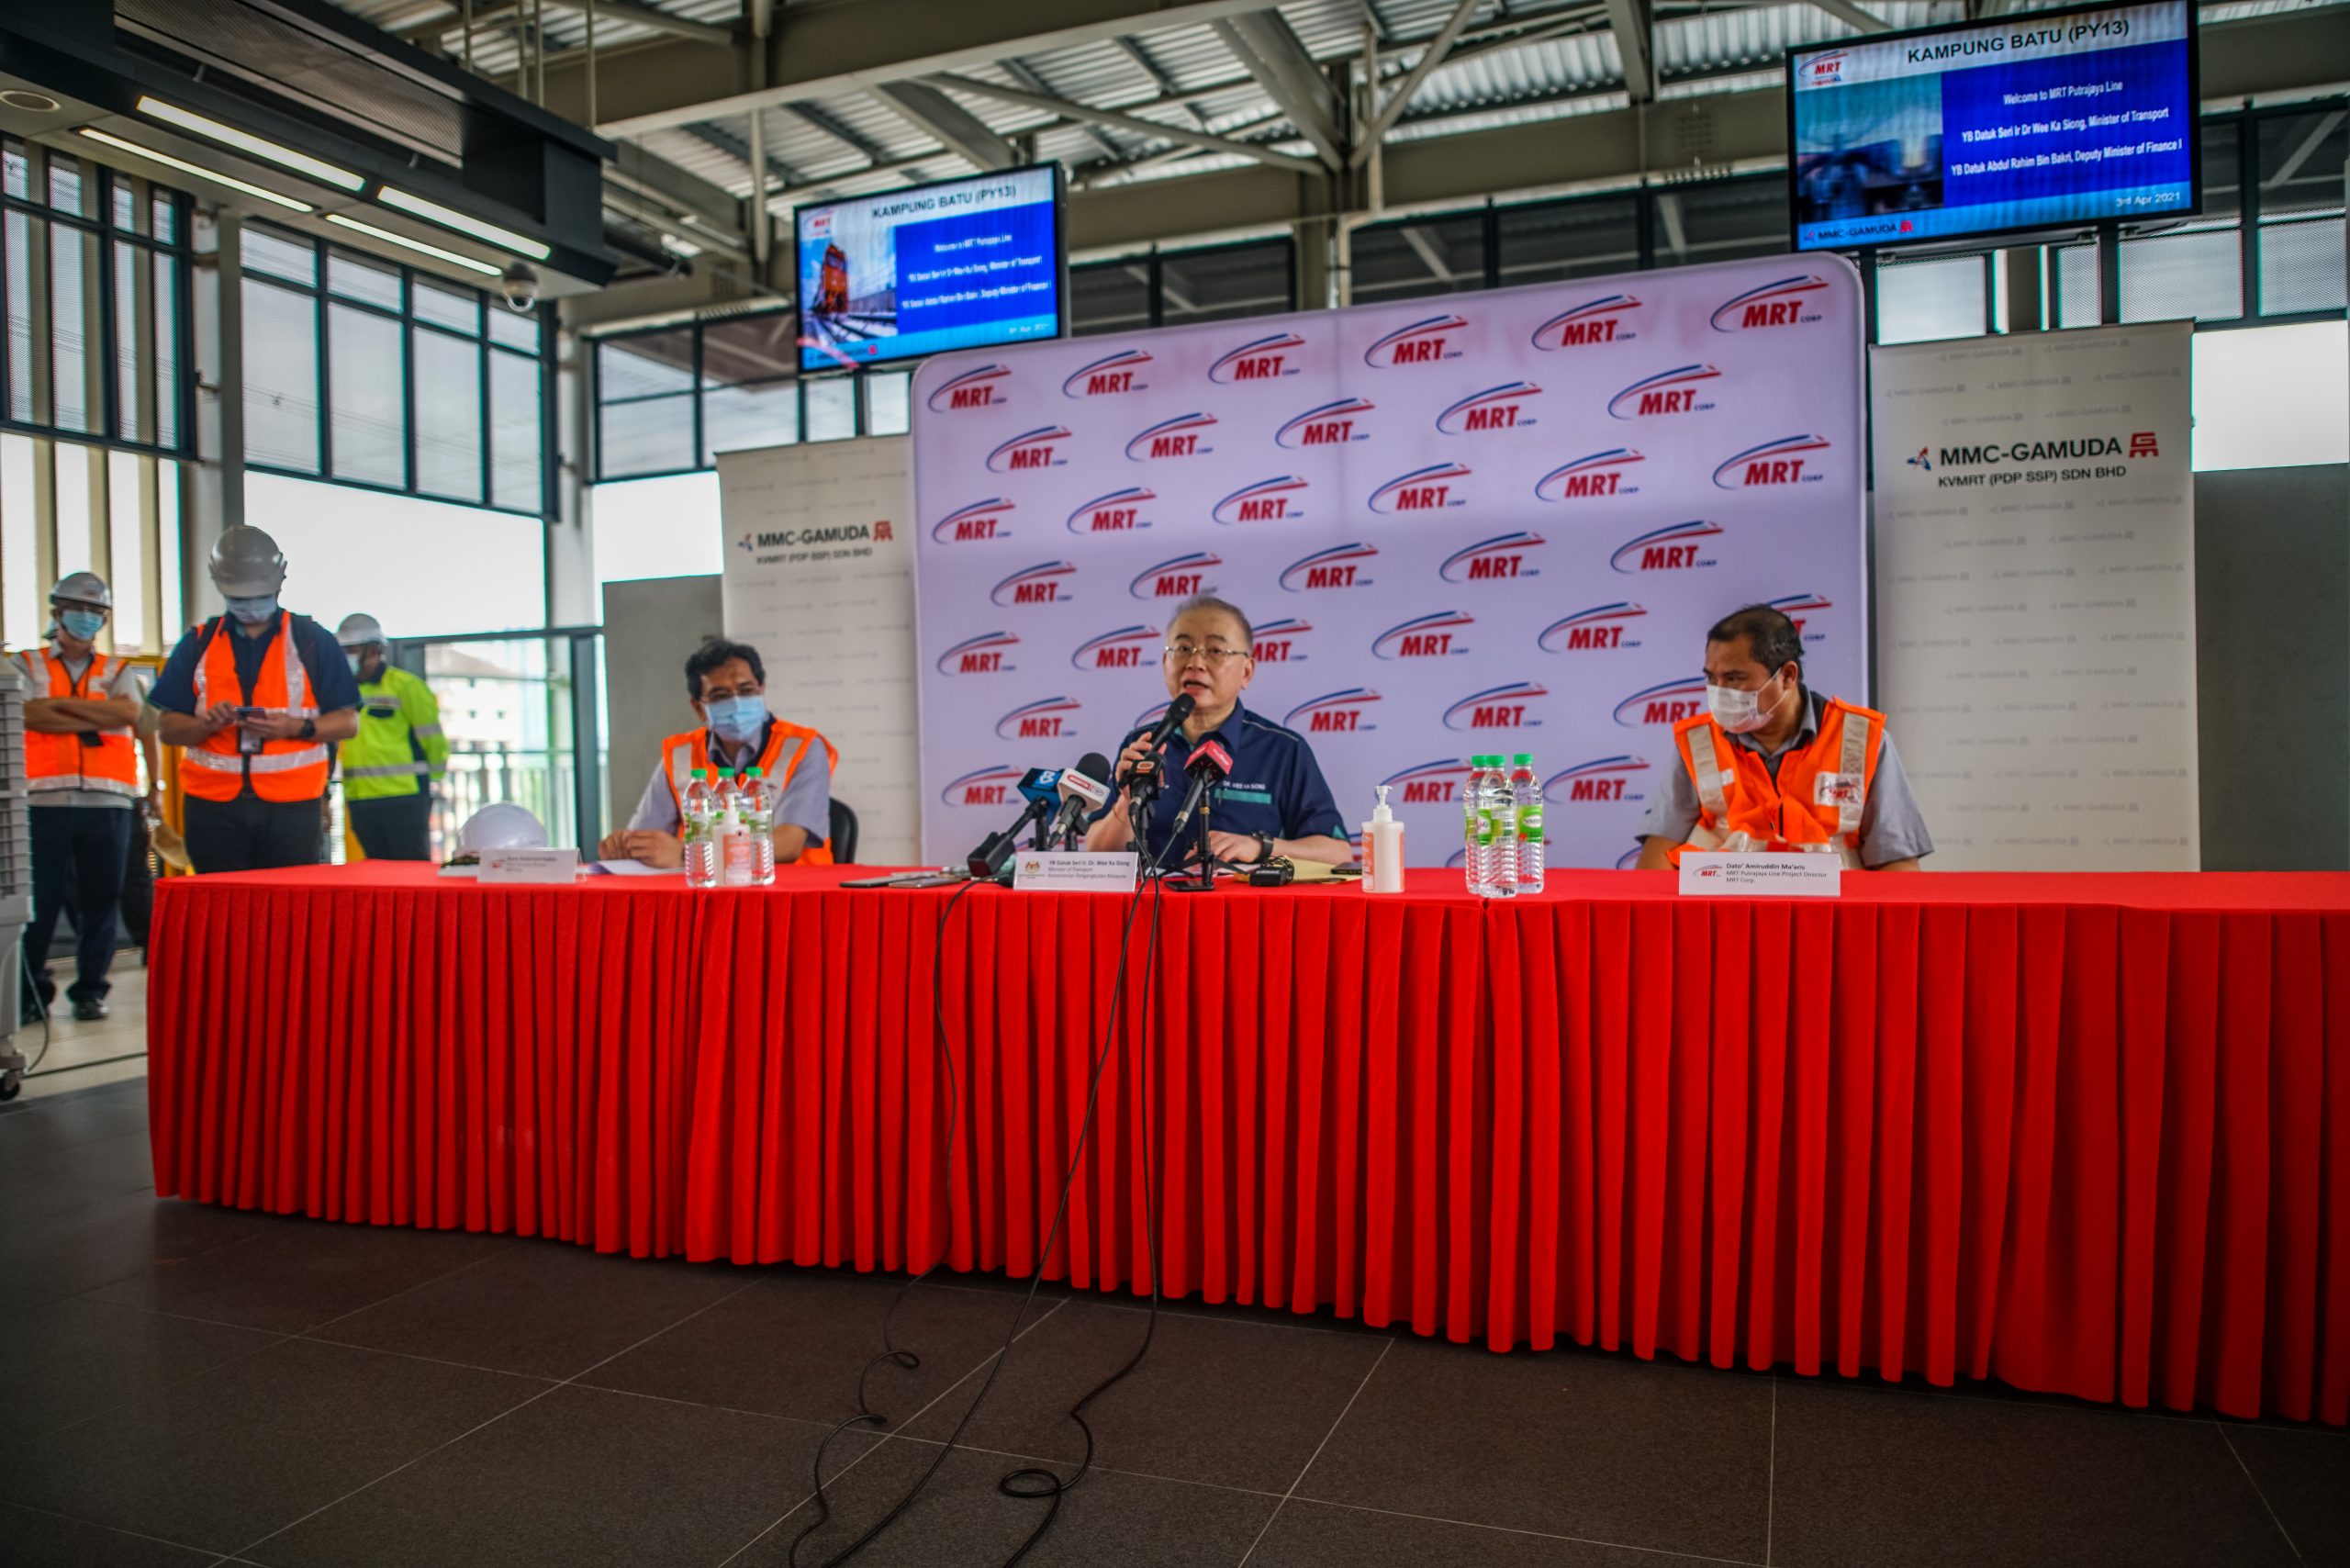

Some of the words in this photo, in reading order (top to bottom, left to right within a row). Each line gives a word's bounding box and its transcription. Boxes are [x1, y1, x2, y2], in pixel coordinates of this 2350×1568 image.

[1908, 37, 2004, 63] KAMPUNG
[2011, 28, 2062, 49] BATU
[2068, 19, 2130, 43] (PY13)
[1815, 61, 1841, 74] MRT
[2003, 93, 2038, 105] Welcome
[2040, 91, 2048, 100] to
[2049, 87, 2066, 99] MRT
[2068, 84, 2104, 97] Putrajaya
[2106, 81, 2123, 92] Line
[1962, 130, 1974, 142] YB
[2088, 114, 2120, 127] Minister
[2121, 111, 2130, 123] of
[2131, 106, 2169, 122] Transport
[1951, 163, 1963, 176] YB
[2103, 145, 2135, 159] Minister
[2136, 141, 2144, 154] of
[2145, 140, 2177, 153] Finance
[873, 199, 934, 218] KAMPUNG
[939, 191, 973, 207] BATU
[2134, 195, 2152, 206] Apr
[2154, 191, 2180, 203] 2021
[1741, 301, 1800, 329] MRT
[1799, 314, 1823, 323] CORP
[1561, 319, 1617, 347] MRT
[1615, 331, 1637, 342] CORP
[1392, 338, 1445, 364] MRT
[1444, 351, 1464, 360] CORP
[1235, 355, 1283, 380] MRT
[1087, 372, 1133, 395] MRT
[950, 386, 993, 409] MRT
[1638, 389, 1695, 415] MRT
[1693, 402, 1717, 412] CORP
[1465, 405, 1518, 431] MRT
[1516, 418, 1538, 427] CORP
[1303, 421, 1353, 444] MRT
[1009, 446, 1052, 469] MRT
[1149, 434, 1197, 458] MRT
[1940, 436, 2122, 466] MMC-GAMUDA
[1744, 460, 1804, 486] MRT
[1801, 474, 1825, 483] CORP
[1938, 474, 1986, 487] KVMRT
[1990, 472, 2022, 487] (PDP
[2026, 470, 2057, 484] SSP)
[2061, 467, 2091, 480] SDN
[2095, 465, 2126, 478] BHD
[1564, 473, 1620, 498] MRT
[1617, 486, 1640, 495] CORP
[1237, 498, 1286, 521] MRT
[1396, 487, 1449, 510] MRT
[1446, 498, 1467, 508] CORP
[955, 520, 997, 540] MRT
[1091, 509, 1136, 531] MRT
[757, 524, 870, 548] MMC-GAMUDA
[1468, 556, 1522, 579] MRT
[1519, 568, 1541, 577] CORP
[1640, 545, 1697, 570] MRT
[1695, 559, 1718, 568] CORP
[1155, 574, 1202, 597] MRT
[1306, 566, 1356, 588] MRT
[1014, 583, 1058, 602] MRT
[1399, 634, 1451, 657] MRT
[1449, 647, 1470, 655] CORP
[1567, 626, 1623, 650] MRT
[1620, 640, 1642, 648] CORP
[959, 653, 1001, 673] MRT
[1095, 647, 1141, 667] MRT
[1309, 711, 1360, 732] MRT
[1471, 706, 1525, 728] MRT
[1644, 701, 1701, 723] MRT
[1018, 718, 1062, 736] MRT
[963, 786, 1006, 804] MRT
[1404, 781, 1455, 802] MRT
[1570, 779, 1625, 801] MRT
[1623, 793, 1645, 801] CORP
